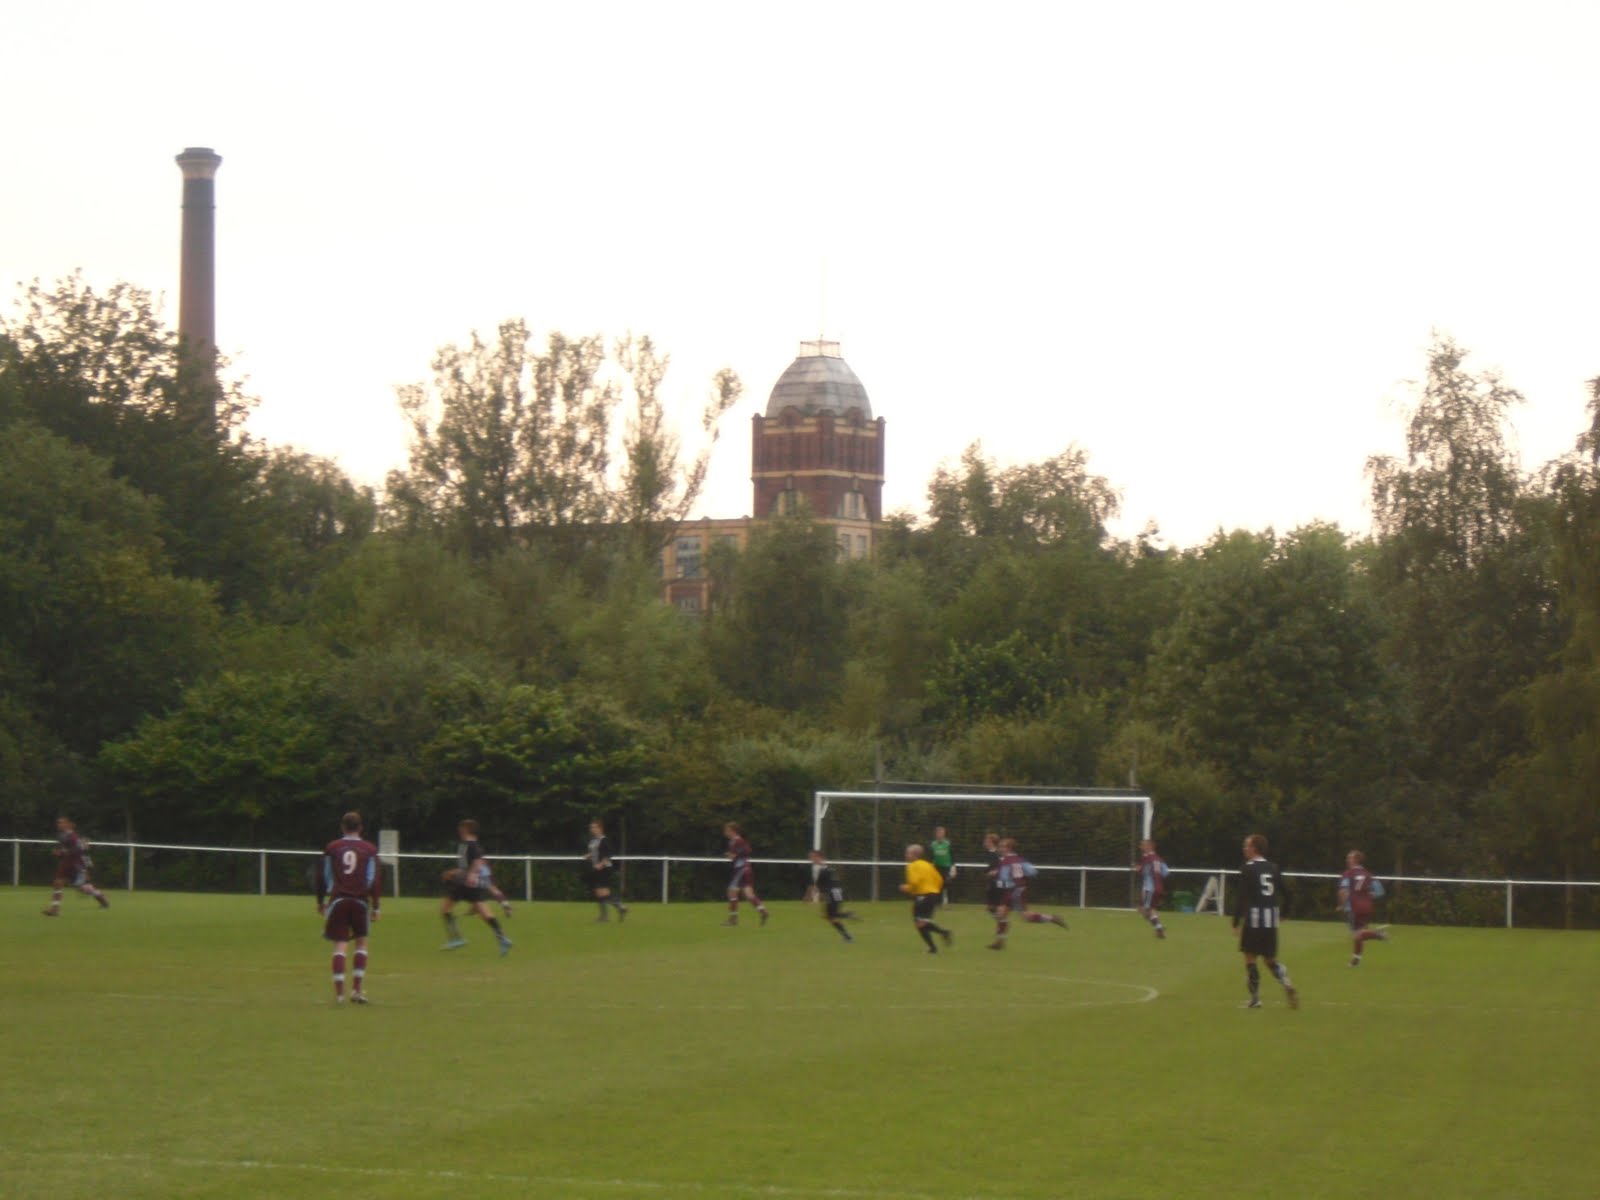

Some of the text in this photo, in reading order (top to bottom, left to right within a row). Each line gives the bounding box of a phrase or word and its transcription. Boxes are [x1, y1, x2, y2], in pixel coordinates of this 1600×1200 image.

[342, 850, 357, 875] 9
[1260, 873, 1275, 896] 5
[1354, 875, 1367, 892] 7
